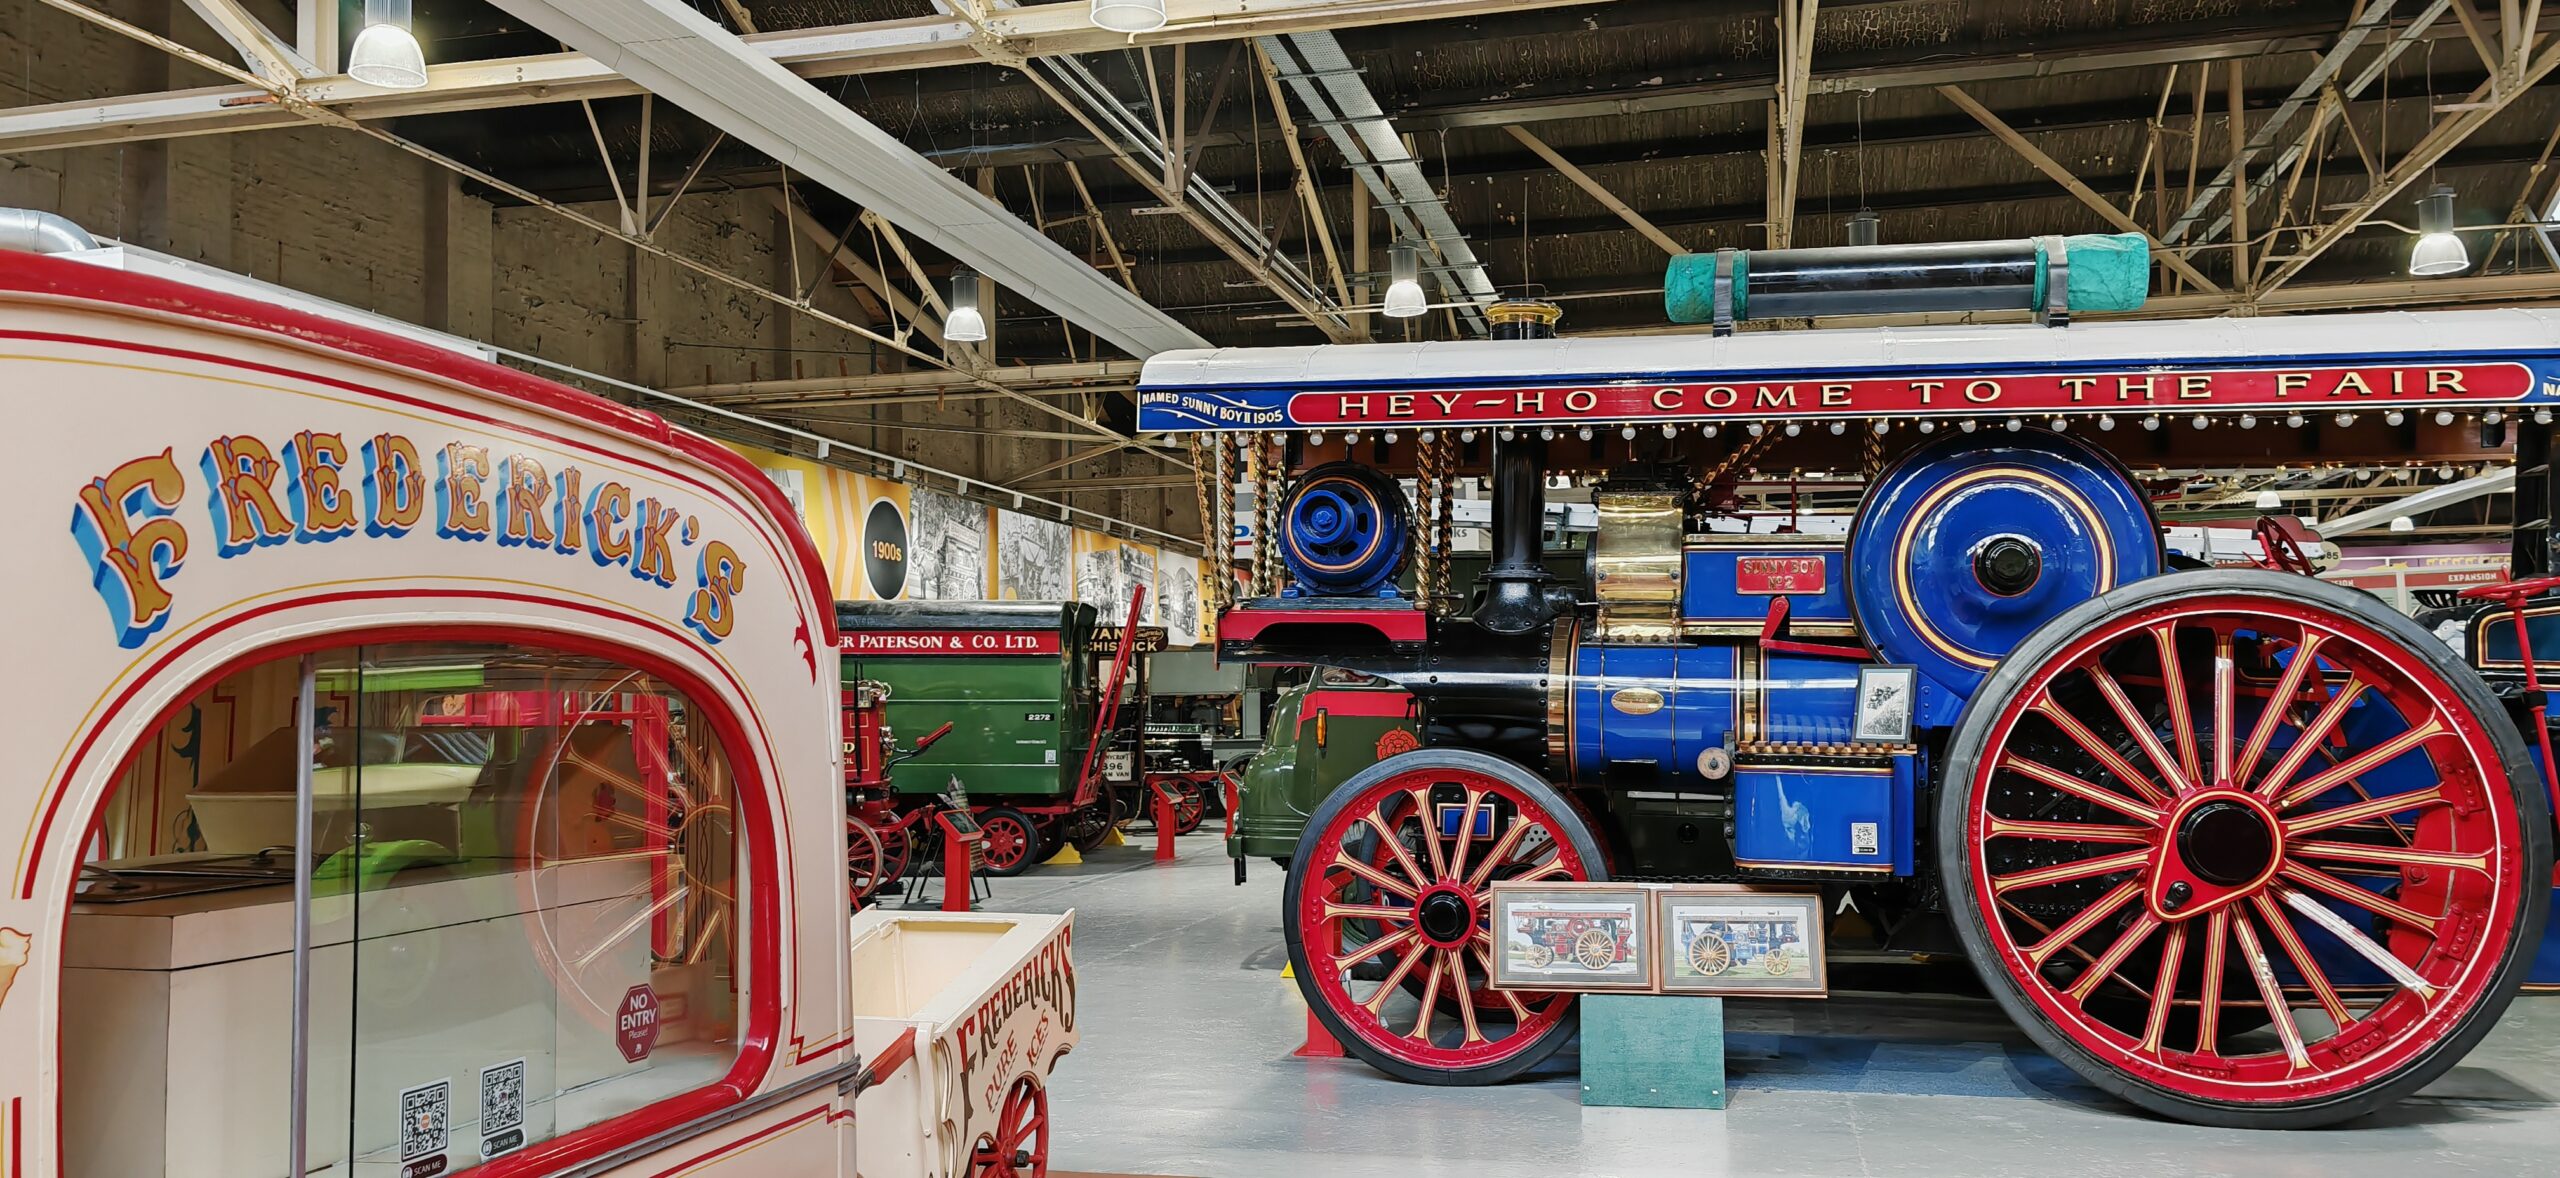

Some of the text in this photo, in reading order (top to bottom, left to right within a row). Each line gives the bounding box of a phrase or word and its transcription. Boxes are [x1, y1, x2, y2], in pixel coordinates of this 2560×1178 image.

[1652, 383, 1853, 410] COME
[1911, 380, 2002, 404] TO
[2061, 375, 2213, 402] THE
[2275, 369, 2468, 397] FAIR
[1142, 392, 1179, 405] NAMED
[1181, 396, 1218, 417] SUNNY
[1253, 409, 1284, 424] 1905
[69, 430, 747, 650] FREDERICK'S
[872, 540, 902, 562] 1900s
[1744, 560, 1817, 576] SUNNY BOY
[2448, 573, 2497, 582] EXPANSION
[860, 634, 943, 648] PATERSON
[950, 636, 964, 649] &
[1089, 641, 1157, 652] HISICK
[630, 993, 648, 1011] NO
[621, 1007, 657, 1031] ENTRY
[957, 924, 1076, 1152] FREDERICKS
[985, 1009, 1049, 1109] PURE ICES
[492, 1134, 518, 1150] SCAN ME
[414, 1159, 441, 1175] SCAN ME
